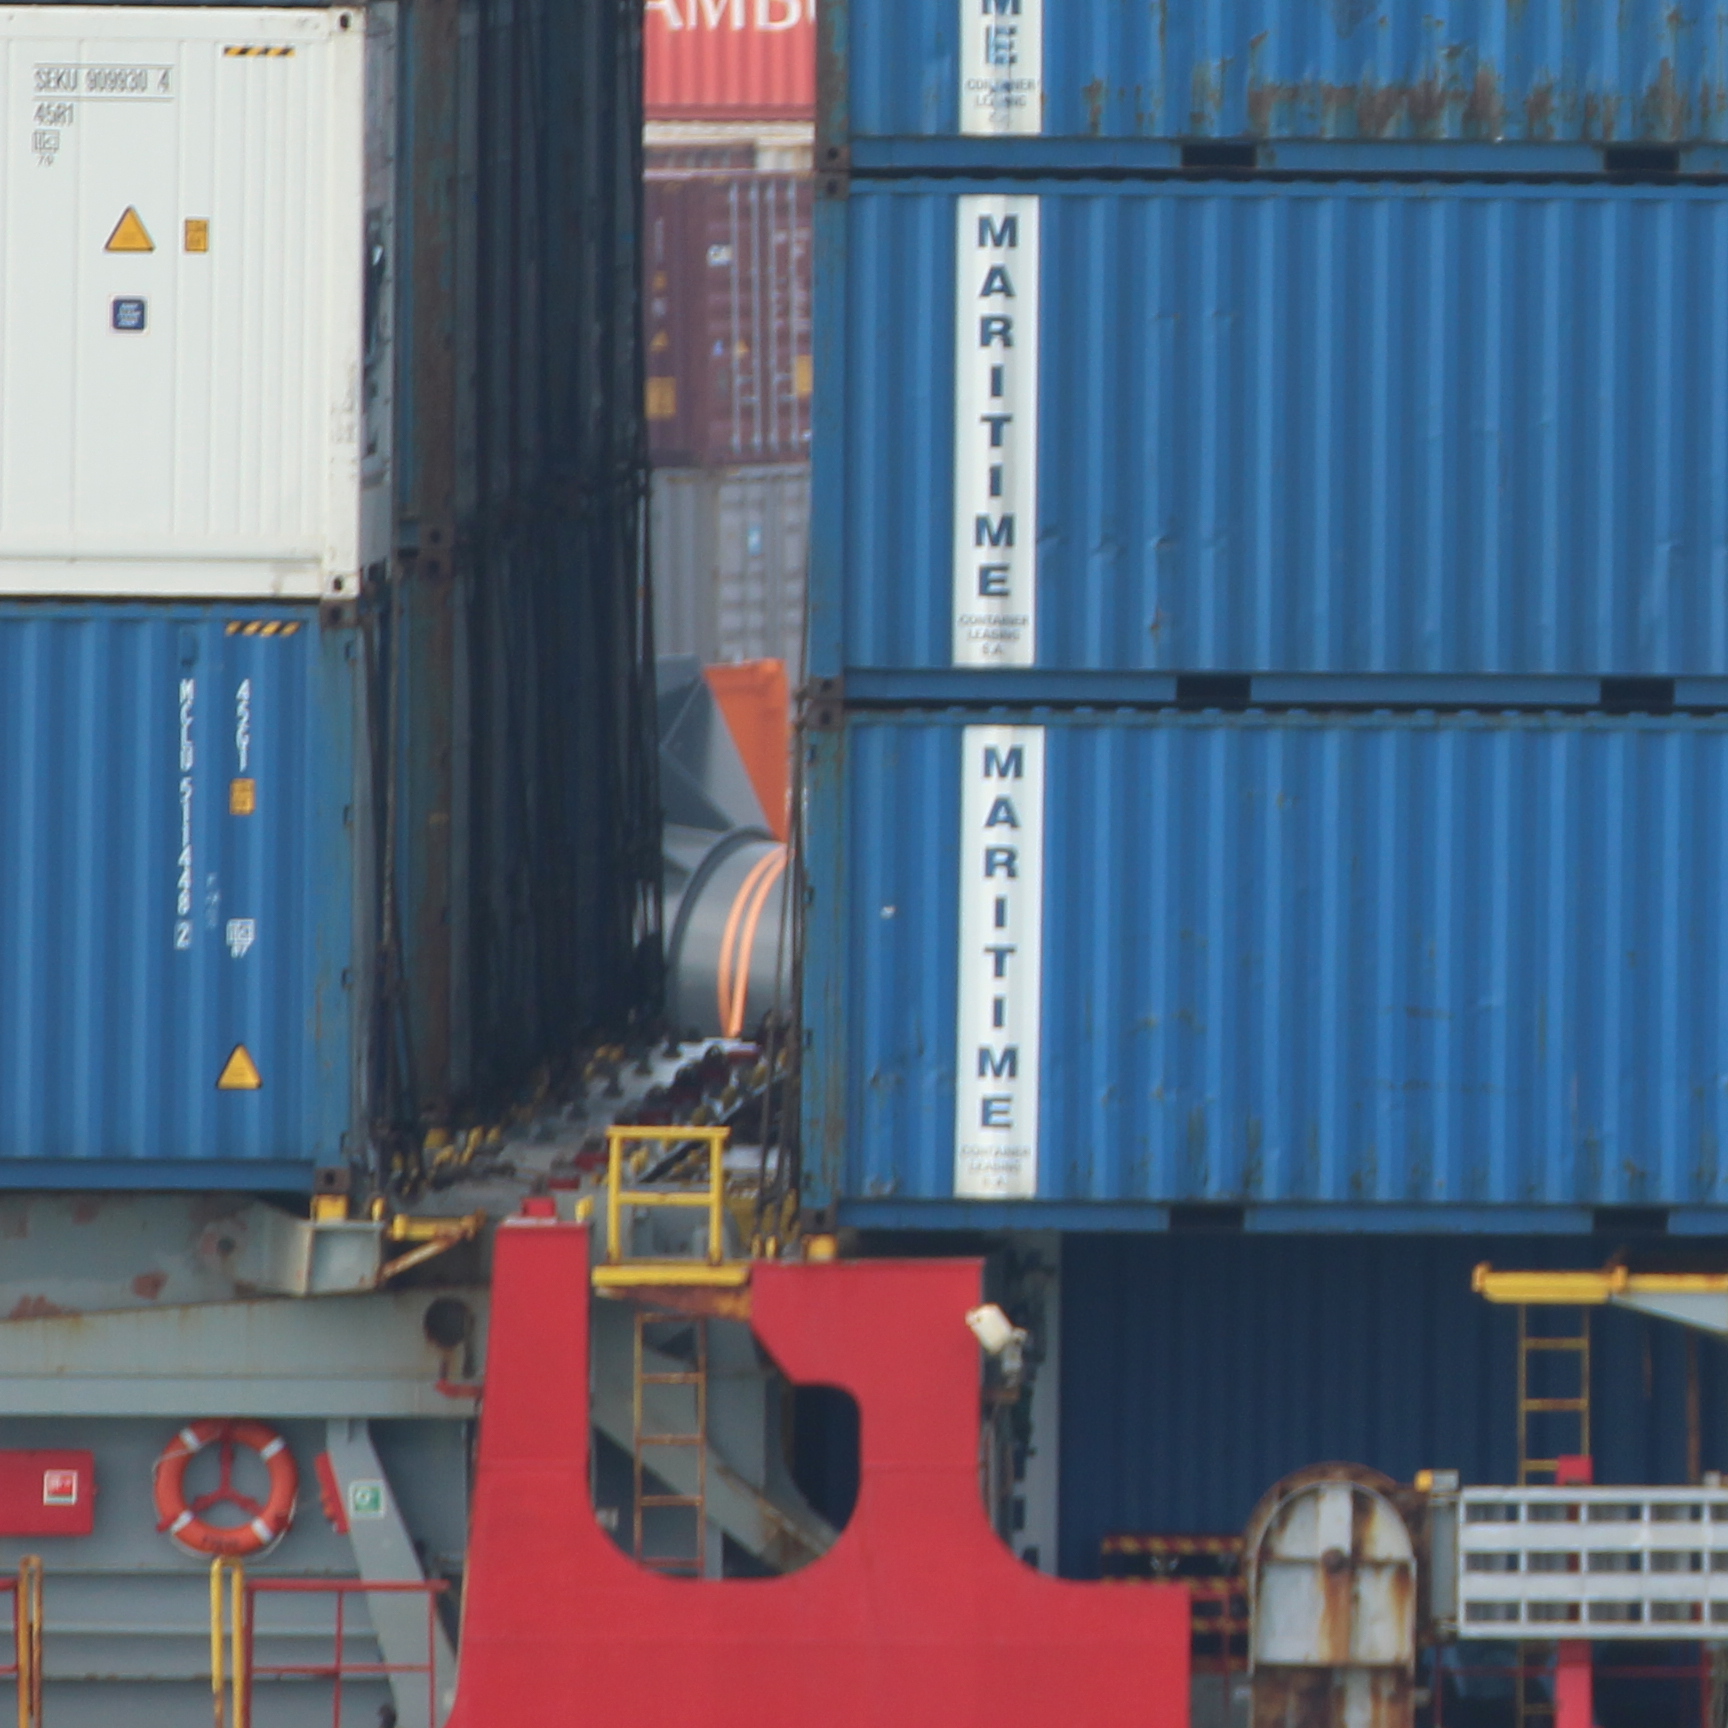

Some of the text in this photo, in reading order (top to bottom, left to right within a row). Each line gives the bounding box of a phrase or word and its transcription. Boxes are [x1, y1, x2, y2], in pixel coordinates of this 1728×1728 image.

[33, 69, 170, 93] SEKU 909930 4
[975, 213, 1020, 601] MARITIME
[178, 680, 197, 950] MCLU 511448 2
[237, 680, 252, 772] 45G1
[977, 744, 1025, 1129] MARITIME
